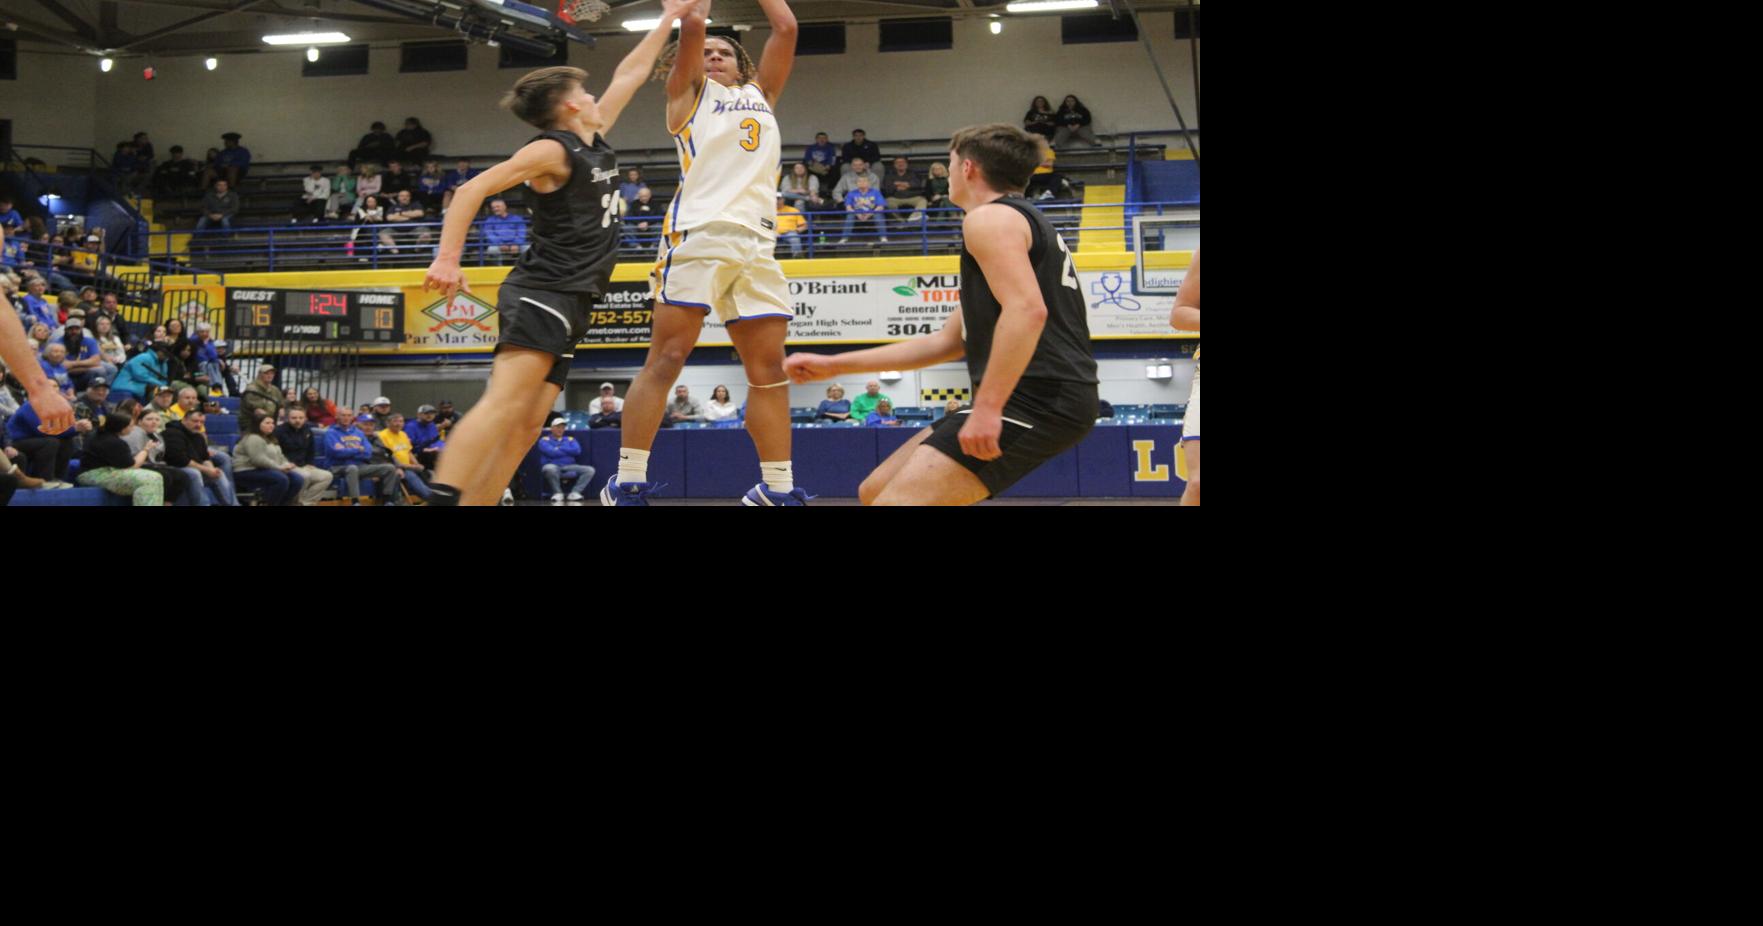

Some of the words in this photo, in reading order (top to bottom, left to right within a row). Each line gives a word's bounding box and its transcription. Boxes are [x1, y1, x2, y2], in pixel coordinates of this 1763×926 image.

[712, 98, 773, 115] Wildca
[740, 118, 760, 152] 3
[788, 281, 868, 295] O'Briant
[232, 290, 275, 301] GUEST
[359, 294, 395, 305] HOME
[310, 293, 347, 316] 1:24
[446, 304, 469, 317] PM
[791, 302, 816, 318] ily
[898, 305, 939, 313] General
[252, 304, 270, 326] 16
[374, 308, 394, 329] 10
[816, 320, 837, 328] High
[840, 318, 872, 327] School
[586, 327, 651, 335] metown.com
[795, 330, 841, 338] Academics
[887, 324, 946, 336] 304-
[405, 333, 429, 344] Par
[435, 333, 462, 343] Mar
[473, 333, 499, 343] Sto
